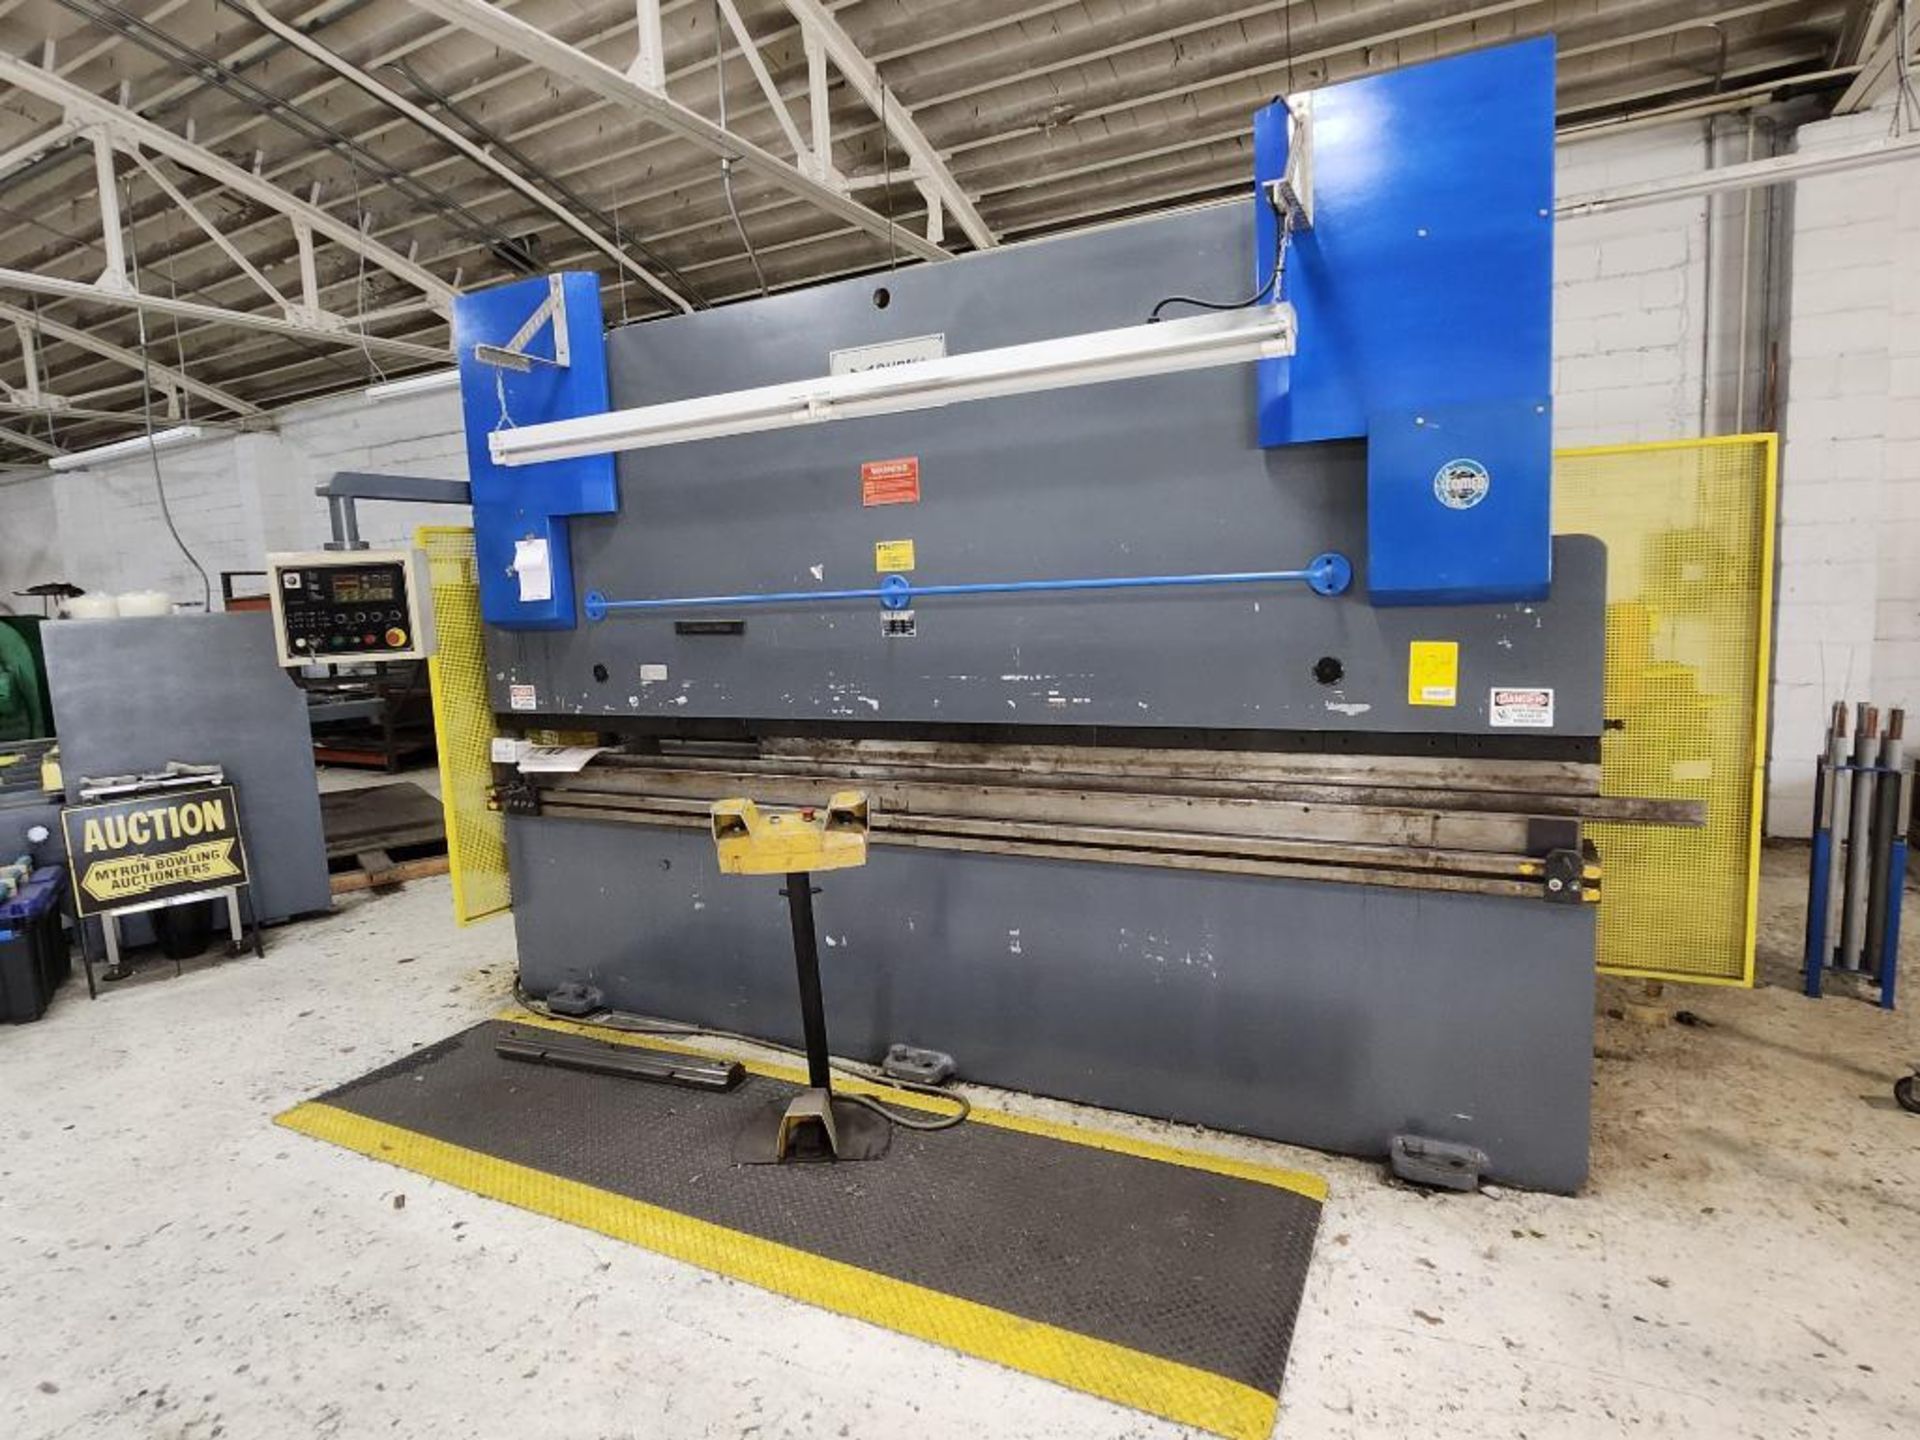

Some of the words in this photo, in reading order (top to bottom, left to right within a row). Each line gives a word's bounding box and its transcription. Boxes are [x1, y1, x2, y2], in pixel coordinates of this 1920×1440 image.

[84, 799, 226, 853] AUCTION
[95, 862, 151, 882] MYRON
[156, 849, 221, 869] BOWLING
[111, 862, 211, 890] AUCTIONEERS
